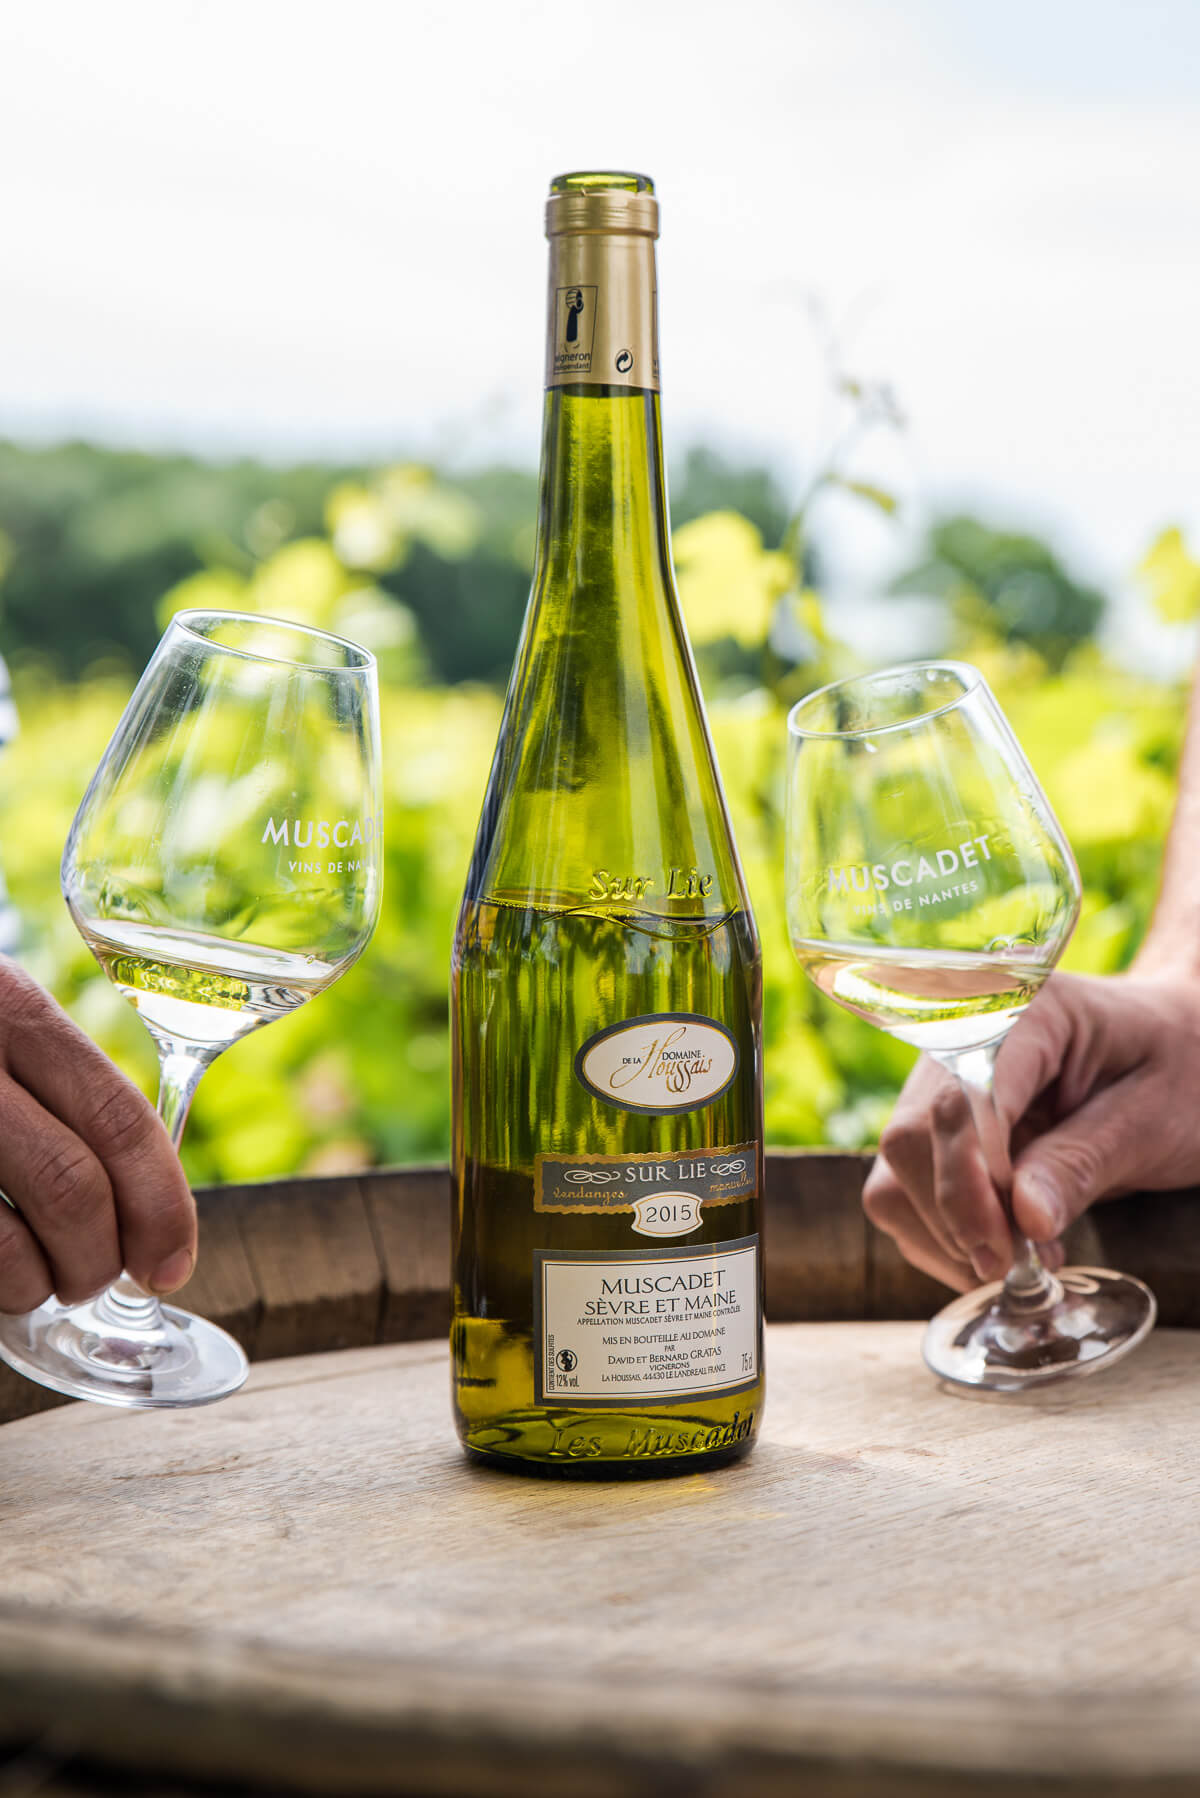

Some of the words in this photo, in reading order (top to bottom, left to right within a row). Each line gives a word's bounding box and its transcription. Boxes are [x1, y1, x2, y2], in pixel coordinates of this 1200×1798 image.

[288, 860, 321, 874] VINS
[328, 862, 343, 873] DE
[827, 834, 992, 893] MUSCADET
[588, 869, 655, 901] Sur
[666, 867, 713, 900] Lie
[853, 903, 887, 916] VINS
[893, 898, 913, 912] DE
[918, 880, 979, 907] NANTES
[622, 1057, 632, 1065] DE
[662, 1049, 702, 1061] DOMAINE
[624, 1166, 671, 1183] SUR
[678, 1162, 706, 1180] LIE
[646, 1204, 692, 1223] 2015
[601, 1269, 726, 1295] MUSCADET
[584, 1297, 650, 1316] SÈVRE
[656, 1298, 680, 1313] ET
[685, 1289, 737, 1311] MAINE
[577, 1316, 624, 1326] APPELLATION
[625, 1315, 662, 1325] MUSCADET
[685, 1312, 692, 1321] ET
[694, 1310, 712, 1320] MAINE
[602, 1336, 618, 1345] MIS
[620, 1336, 632, 1345] EN
[633, 1333, 679, 1344] BOUTEILLE
[680, 1332, 691, 1340] AU
[693, 1327, 726, 1340] DOMAINE
[636, 1356, 647, 1364] ET
[690, 1346, 722, 1360] GRATAS
[642, 1371, 664, 1381] 44430
[665, 1371, 674, 1379] LE
[674, 1367, 706, 1379] LANDREAU
[707, 1363, 726, 1374] FRANCE
[649, 1361, 690, 1371] VIGNERONS
[556, 1374, 569, 1387] 12%
